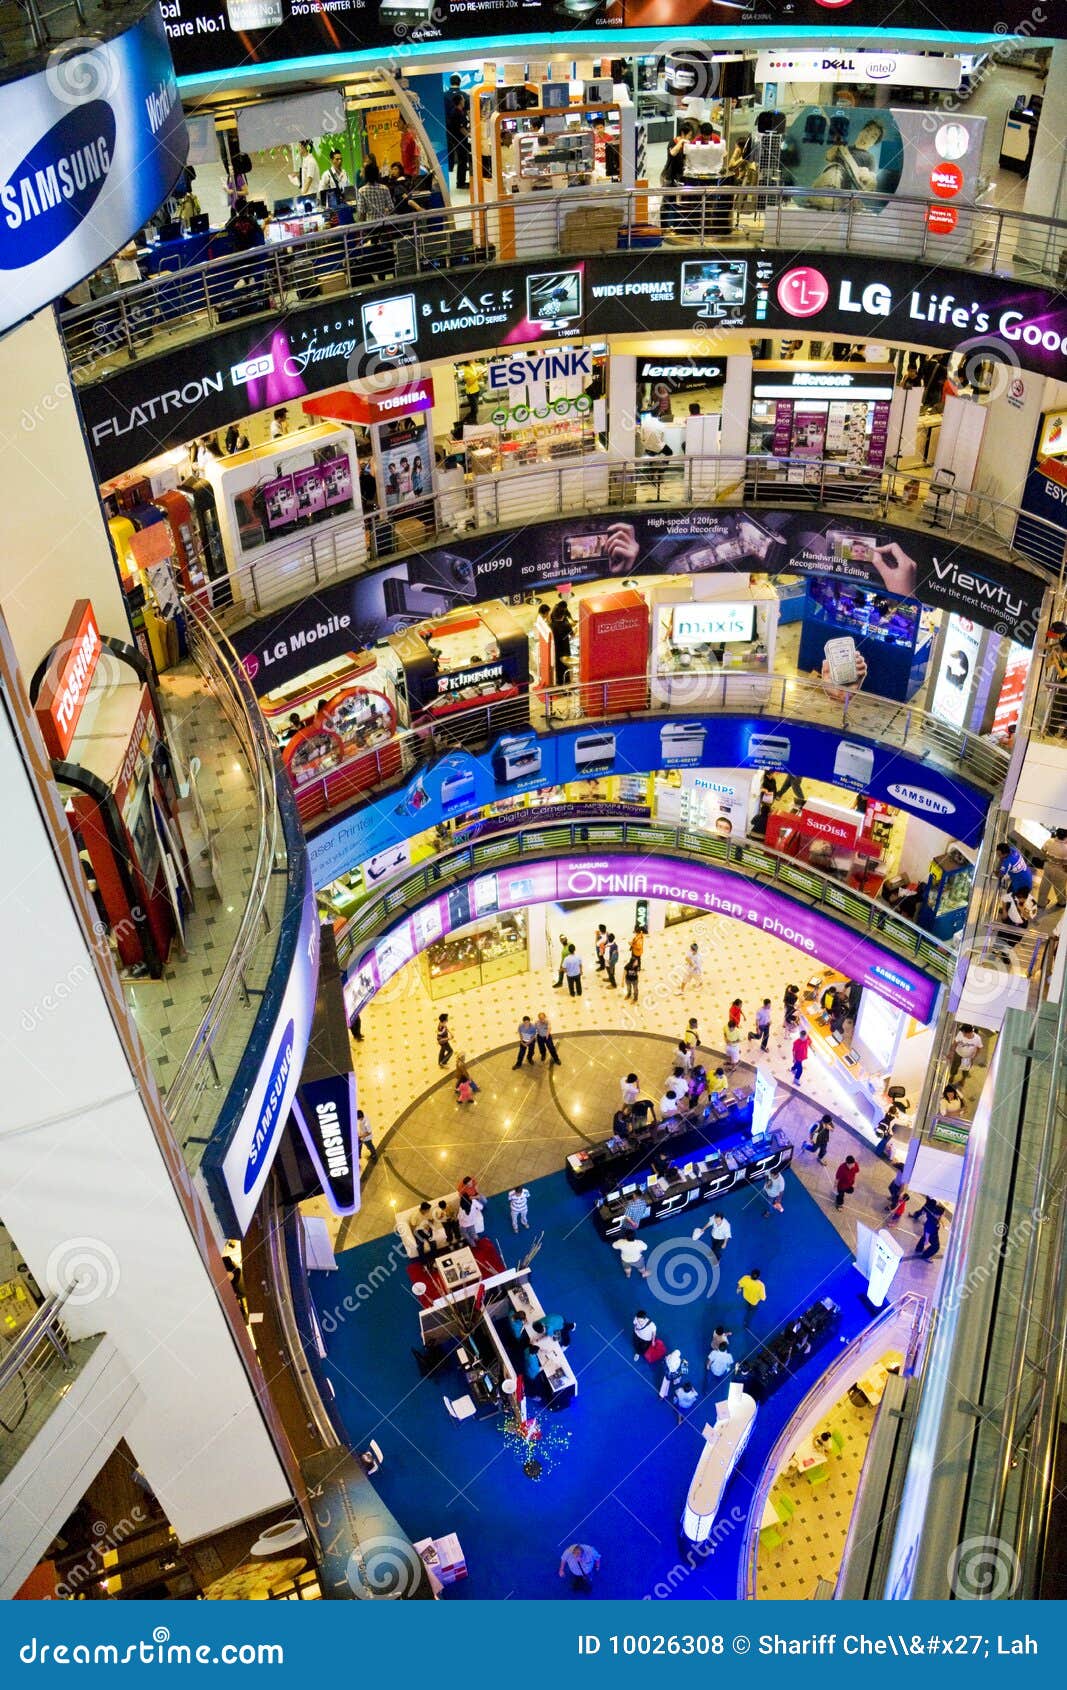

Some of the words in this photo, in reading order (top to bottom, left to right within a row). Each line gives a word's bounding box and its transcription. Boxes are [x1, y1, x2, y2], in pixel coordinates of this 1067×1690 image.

[291, 3, 310, 16] DVD
[310, 1, 351, 14] RE-WRITER
[450, 2, 466, 13] DVD
[466, 1, 505, 12] RE-WRITER
[505, 0, 519, 9] 20x
[196, 15, 226, 34] No.1
[822, 59, 856, 71] DELL
[869, 61, 894, 74] intel
[0, 136, 110, 230] SAMSUNG
[592, 284, 624, 298] WIDE
[625, 281, 675, 296] FORMAT
[650, 292, 675, 302] SERIES
[421, 288, 515, 317] BLACK
[838, 279, 893, 317] LG
[909, 291, 990, 333] Life's
[279, 318, 355, 346] FLATRON
[431, 314, 485, 334] DIAMOND
[485, 313, 507, 325] SERIES
[283, 338, 357, 377] Fantasy
[490, 350, 591, 389] ESYINK
[641, 363, 723, 378] lenovo
[792, 372, 853, 387] Microsoft
[91, 370, 224, 447] FLATRON
[233, 357, 270, 382] LCD
[377, 390, 428, 412] TOSHIBA
[647, 516, 691, 527] High-speed
[691, 516, 719, 528] 120fps
[666, 524, 688, 535] Video
[689, 524, 729, 535] Recording
[476, 557, 513, 575] KU990
[521, 565, 536, 575] ISO
[537, 562, 553, 572] 800
[553, 560, 560, 569] &
[789, 558, 834, 572] Recognition
[835, 563, 843, 572] &
[843, 566, 870, 581] Editing
[801, 551, 848, 568] Handwriting
[928, 580, 947, 595] View
[948, 587, 961, 600] the
[961, 593, 979, 608] next
[979, 600, 1019, 627] technology
[678, 615, 745, 635] maxis
[262, 641, 288, 667] LG
[291, 613, 351, 652] Mobile
[56, 622, 99, 735] TOSHIBA
[449, 664, 503, 690] Kingston
[121, 709, 147, 788] TOSHIBA
[694, 778, 735, 796] PHILIPS
[893, 783, 950, 816] SAMSUNG
[498, 809, 529, 824] Digital
[531, 803, 575, 816] Camera
[806, 817, 848, 840] SanDisk
[568, 861, 609, 870] SAMSUNG
[567, 870, 648, 895] OMNIA
[652, 884, 699, 901] more
[703, 892, 743, 917] than
[747, 910, 758, 922] a
[762, 915, 818, 954] phone.
[875, 966, 912, 992] SAMSUNG
[248, 1043, 293, 1166] SAMSUNG
[315, 1100, 350, 1178] SAMSUNG
